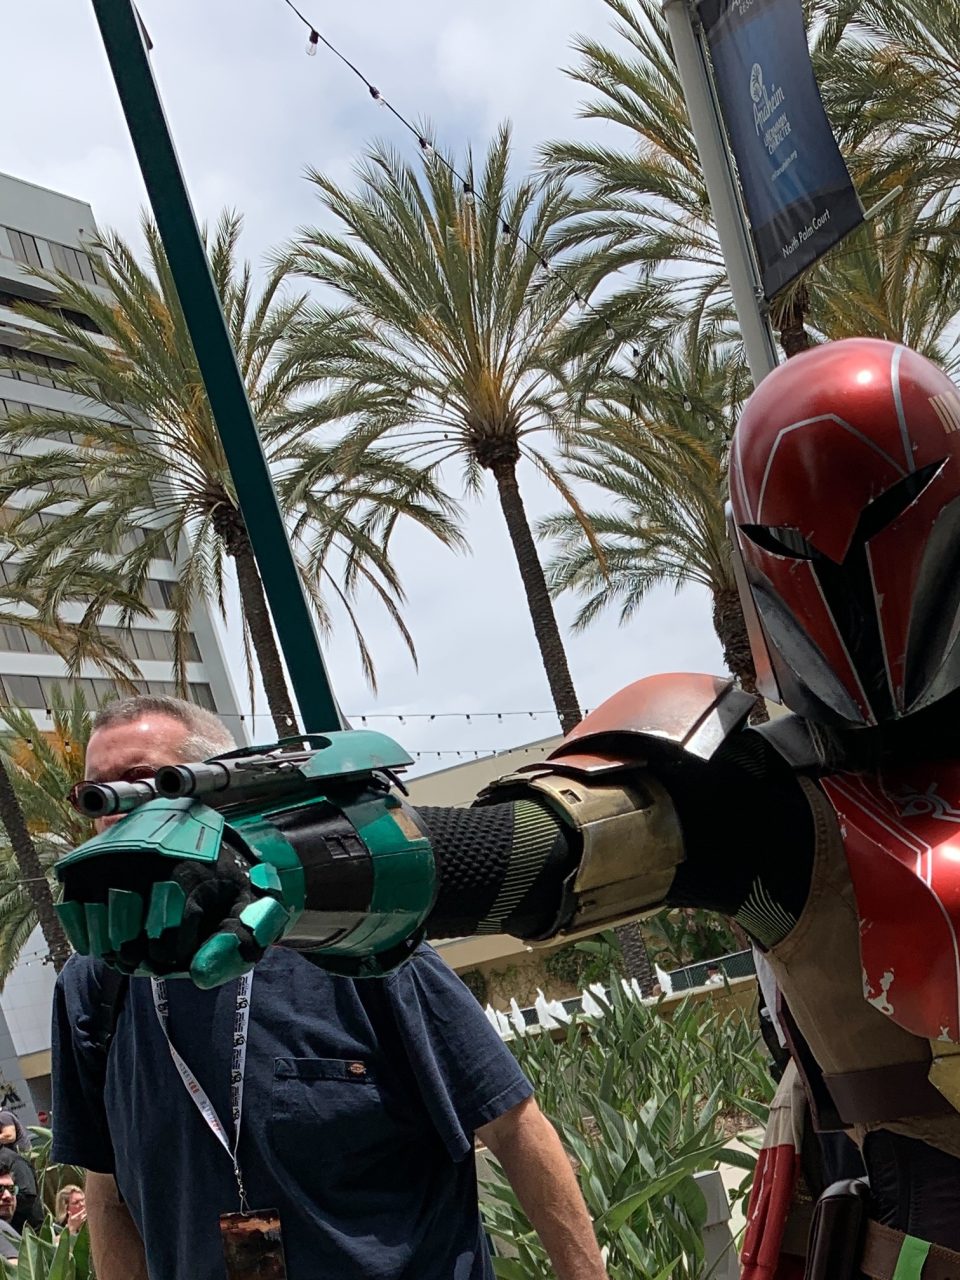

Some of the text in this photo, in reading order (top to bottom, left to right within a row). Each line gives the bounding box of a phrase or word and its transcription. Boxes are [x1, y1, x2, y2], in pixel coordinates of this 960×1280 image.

[753, 83, 785, 136] Anaheim
[782, 208, 830, 258] North Palm Court
